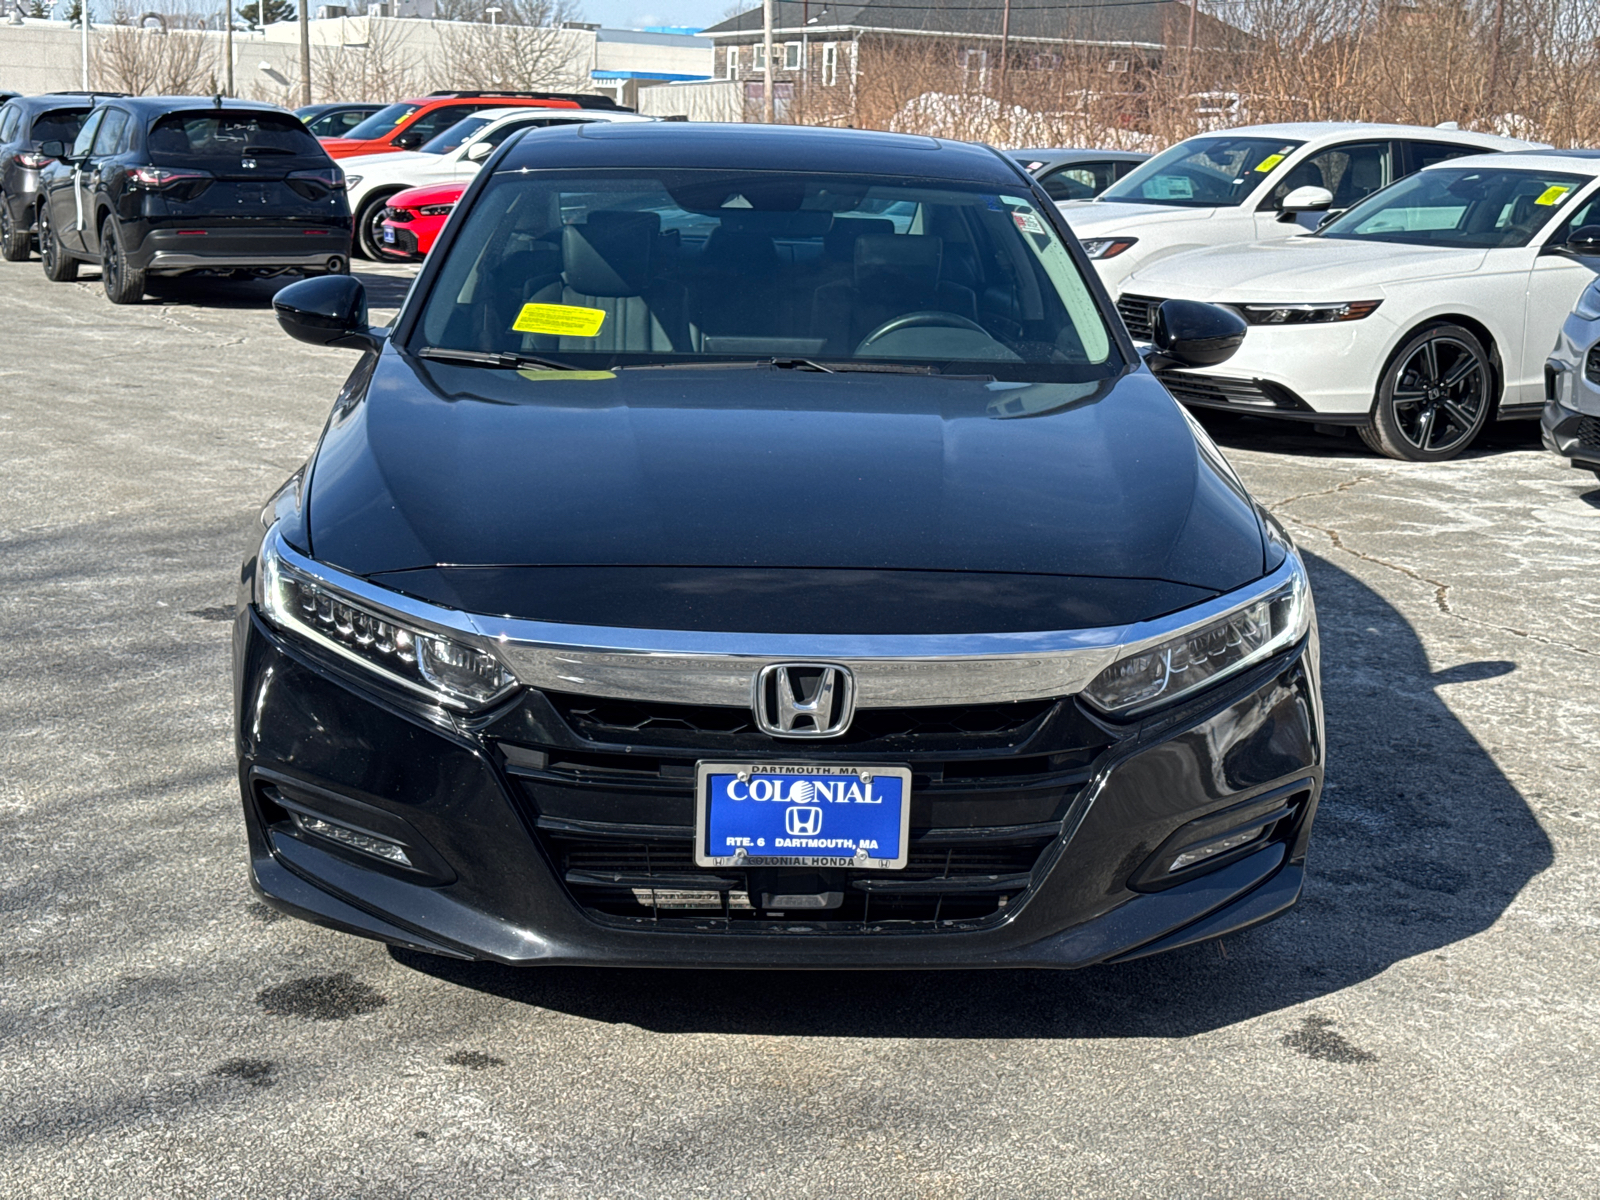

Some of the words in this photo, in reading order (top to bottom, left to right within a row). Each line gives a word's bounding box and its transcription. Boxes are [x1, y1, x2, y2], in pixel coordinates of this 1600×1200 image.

[752, 765, 835, 775] DARTMOUTH,
[839, 767, 859, 775] MA
[726, 779, 883, 804] COLONIAL
[726, 837, 754, 847] RTE.
[757, 838, 766, 847] 6
[774, 838, 857, 850] DARTMOUTH,
[859, 839, 879, 849] MA
[748, 856, 808, 866] COLONIAL
[812, 857, 855, 867] HONDA
